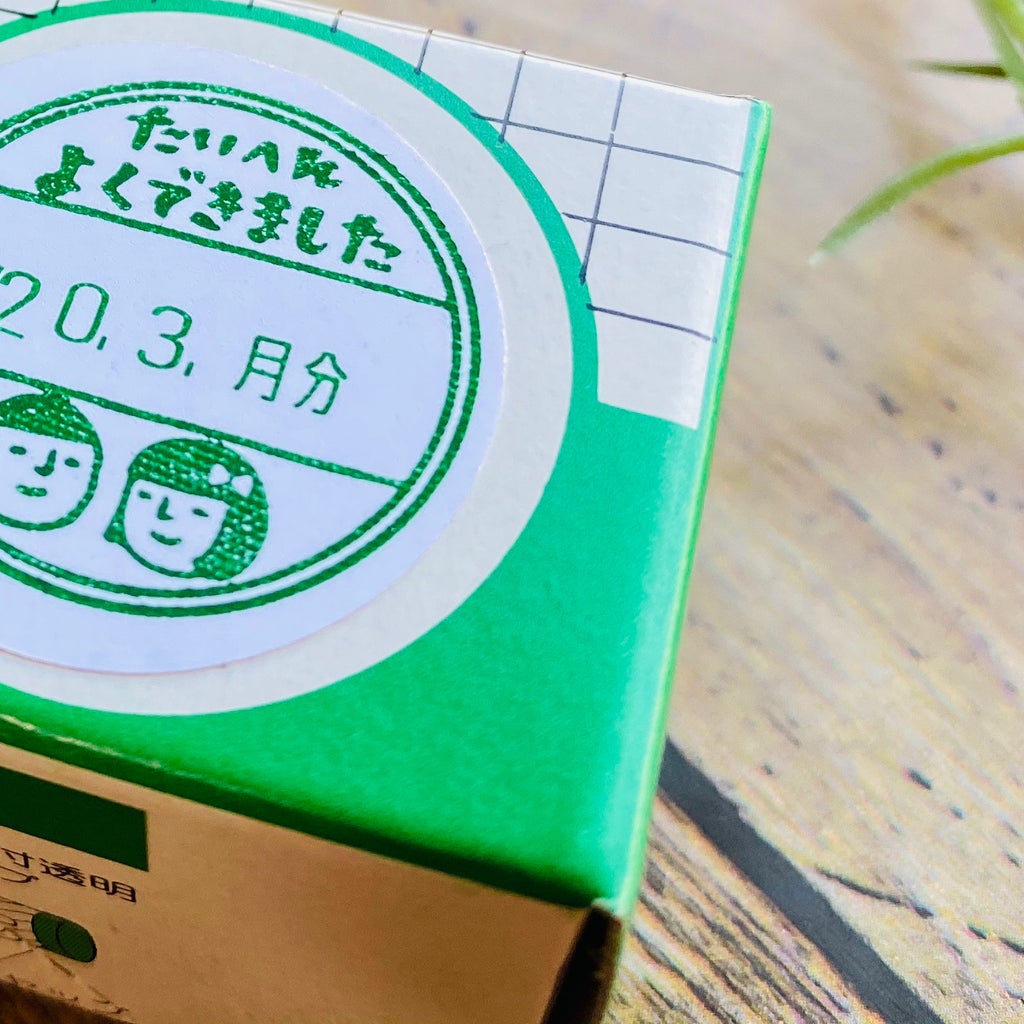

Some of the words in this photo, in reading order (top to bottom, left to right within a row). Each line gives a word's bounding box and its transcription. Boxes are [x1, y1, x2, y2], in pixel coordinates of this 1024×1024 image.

[126, 106, 343, 190] たいへん
[33, 144, 402, 273] よくできました
